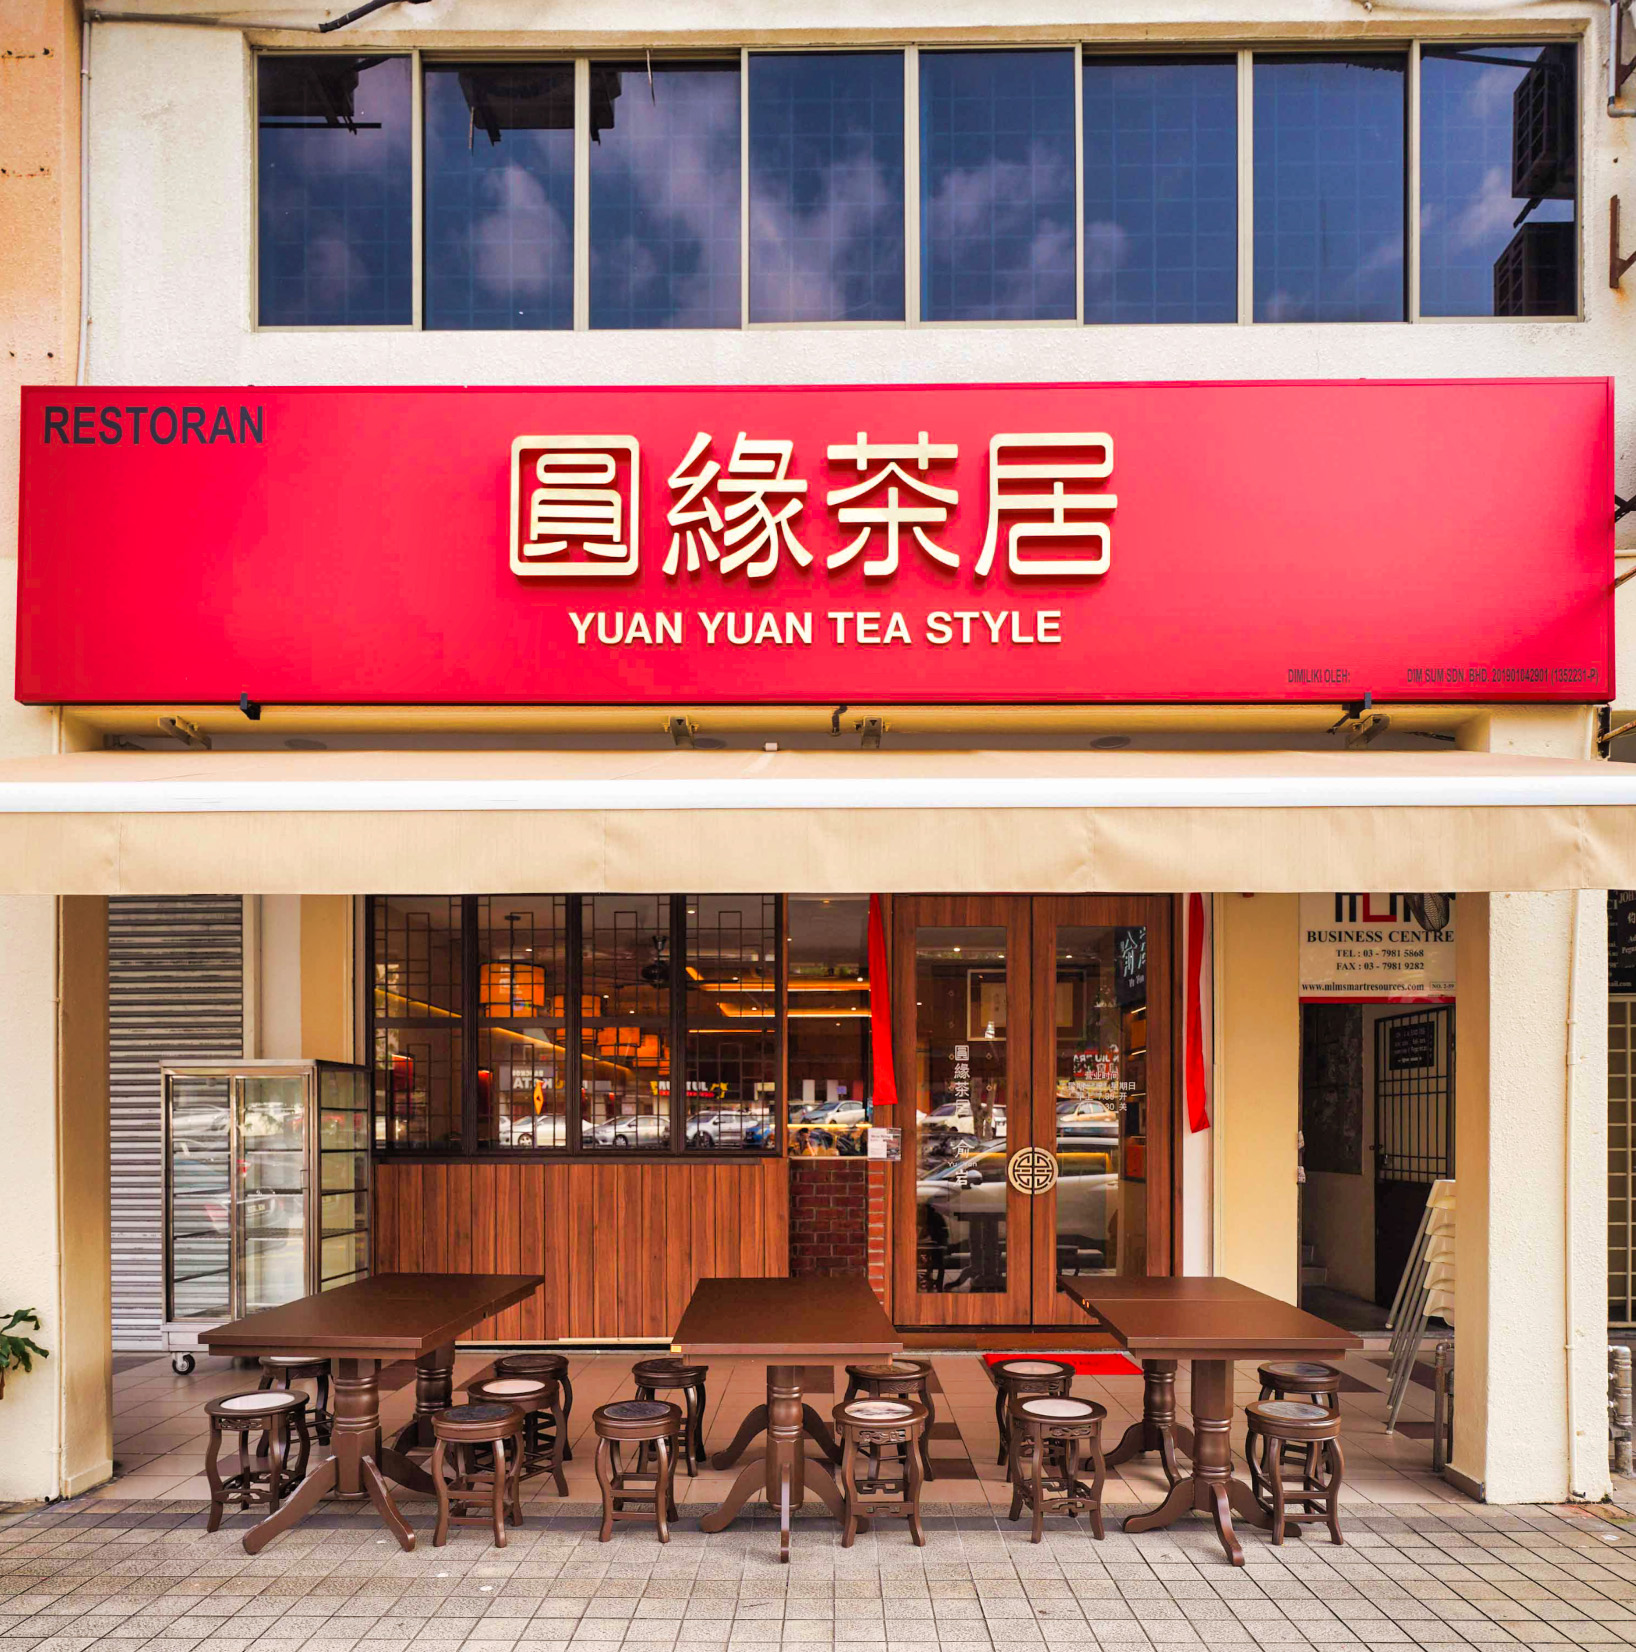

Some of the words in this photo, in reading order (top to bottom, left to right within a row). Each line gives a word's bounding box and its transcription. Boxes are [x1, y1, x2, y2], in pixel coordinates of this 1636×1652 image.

[44, 405, 263, 445] RESTORAN
[509, 431, 1118, 579] 圓緣茶居
[568, 612, 683, 645] YUAN
[698, 612, 813, 645] YUAN
[828, 611, 912, 644] TEA
[925, 610, 1062, 644] STYLE
[1288, 668, 1322, 683] DIMILIKI
[1324, 668, 1350, 683] OLEH:
[1407, 668, 1423, 683] DIM
[1425, 668, 1443, 683] SUM
[1446, 668, 1466, 683] SDN.
[1469, 668, 1490, 683] BHD.
[1491, 667, 1549, 683] 201901042901
[1307, 930, 1383, 943] BUSINESS
[1388, 930, 1455, 943] CENTRE
[1336, 949, 1356, 957] TEL
[1363, 949, 1373, 957] 03
[1382, 949, 1401, 957] 7981
[1404, 949, 1424, 957] 5868
[1336, 962, 1356, 970] FAX
[1363, 962, 1374, 970] 03
[1382, 962, 1401, 970] 7981
[1404, 962, 1424, 970] 9282
[1302, 982, 1424, 992] www.mlmsmartresources.com
